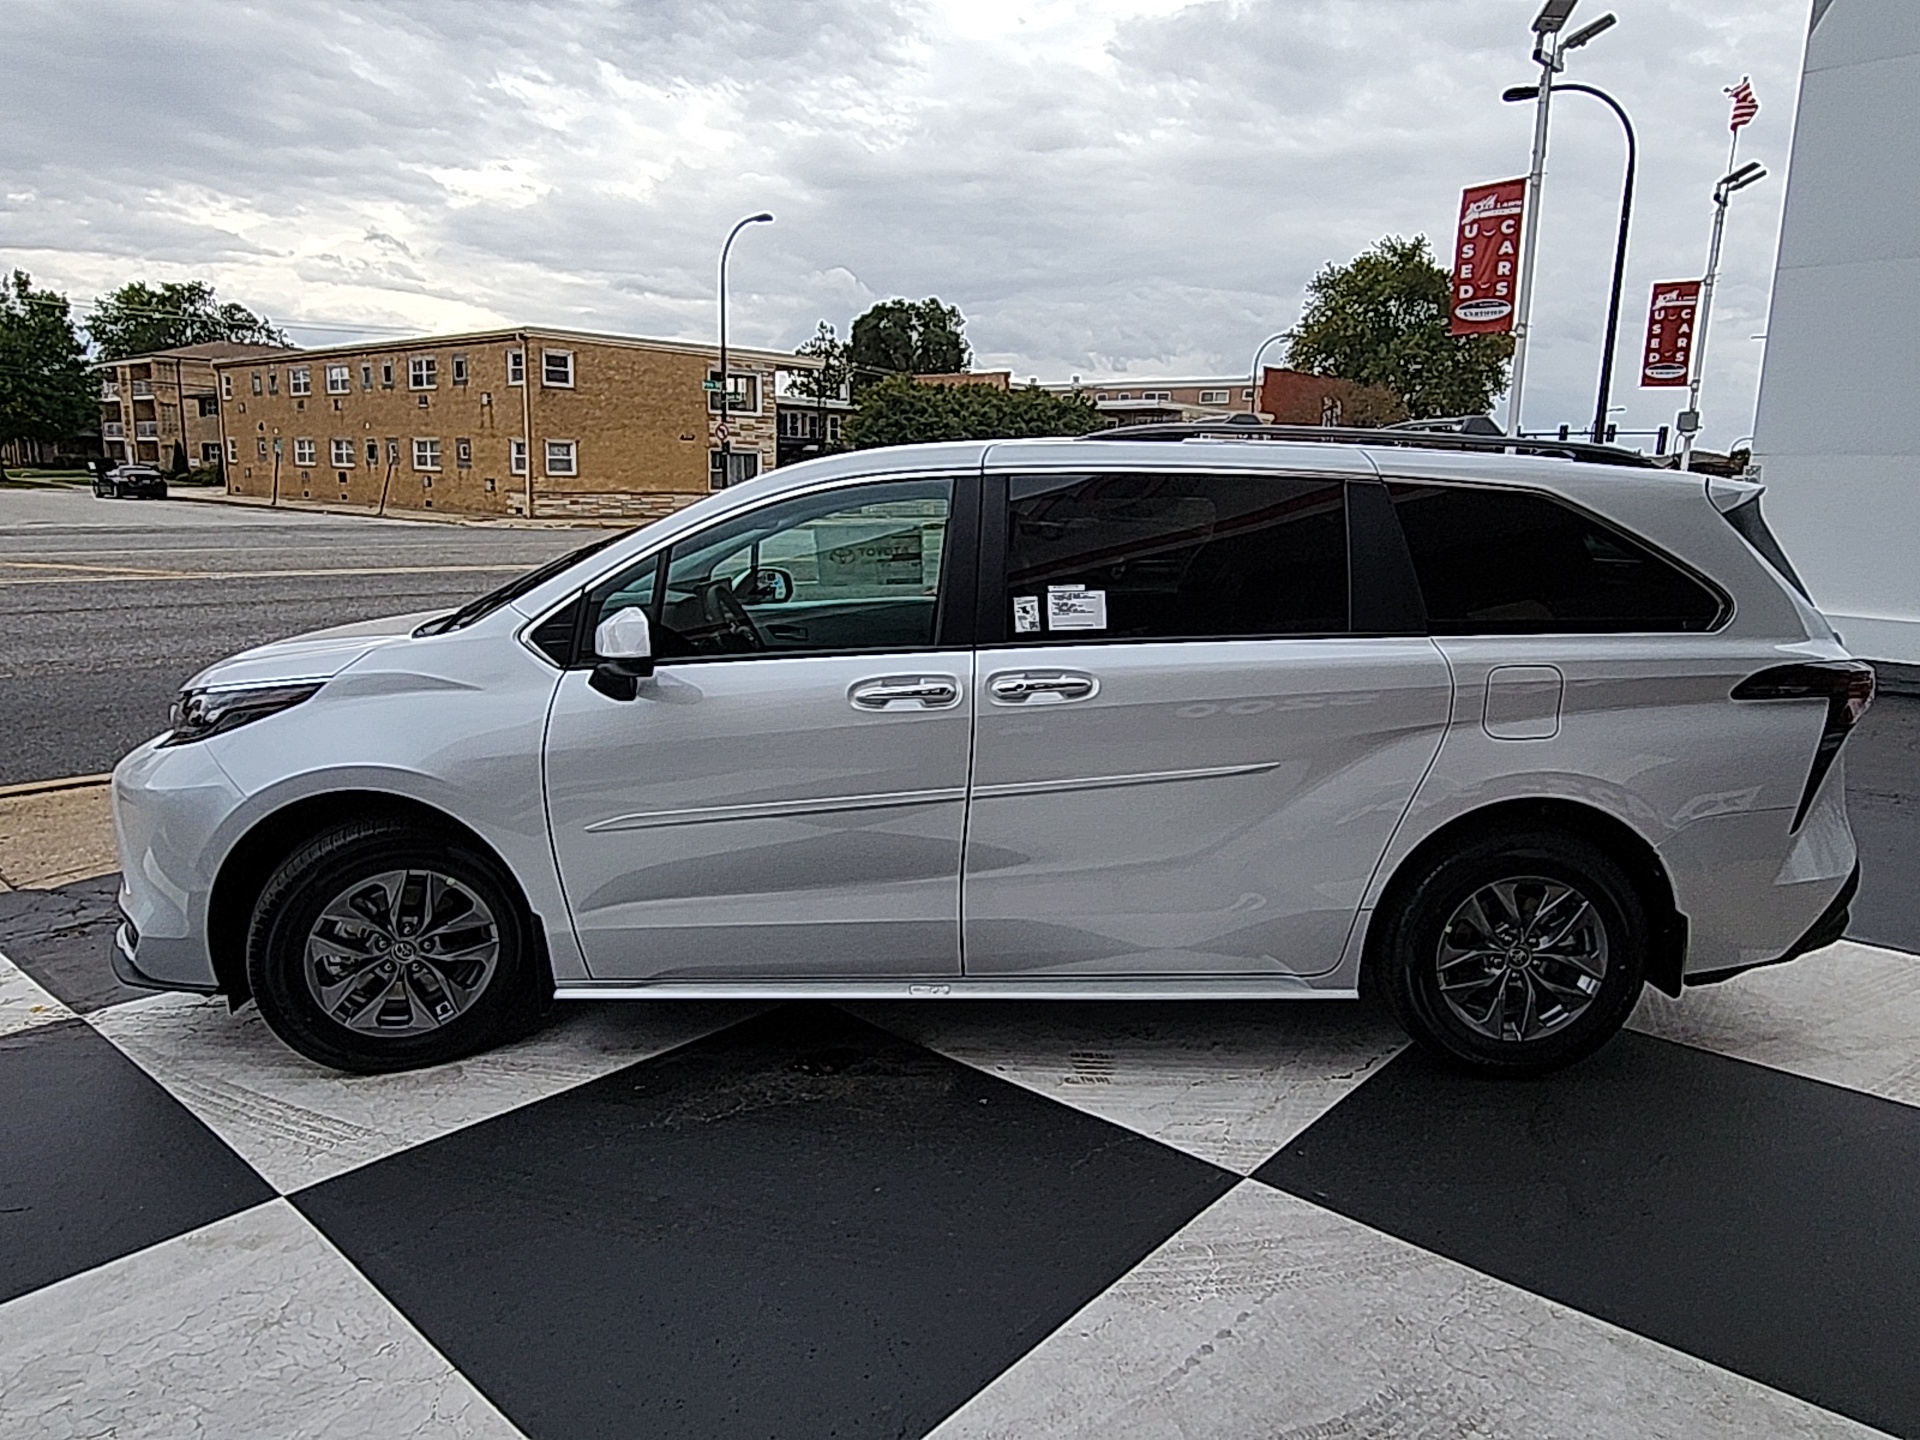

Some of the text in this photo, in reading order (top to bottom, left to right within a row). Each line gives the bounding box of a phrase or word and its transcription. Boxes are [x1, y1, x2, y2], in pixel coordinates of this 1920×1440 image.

[1459, 223, 1479, 300] USED
[1495, 219, 1515, 296] CARS
[1648, 309, 1665, 363] USED
[1675, 308, 1692, 362] CARS
[858, 546, 909, 557] TOYOTA
